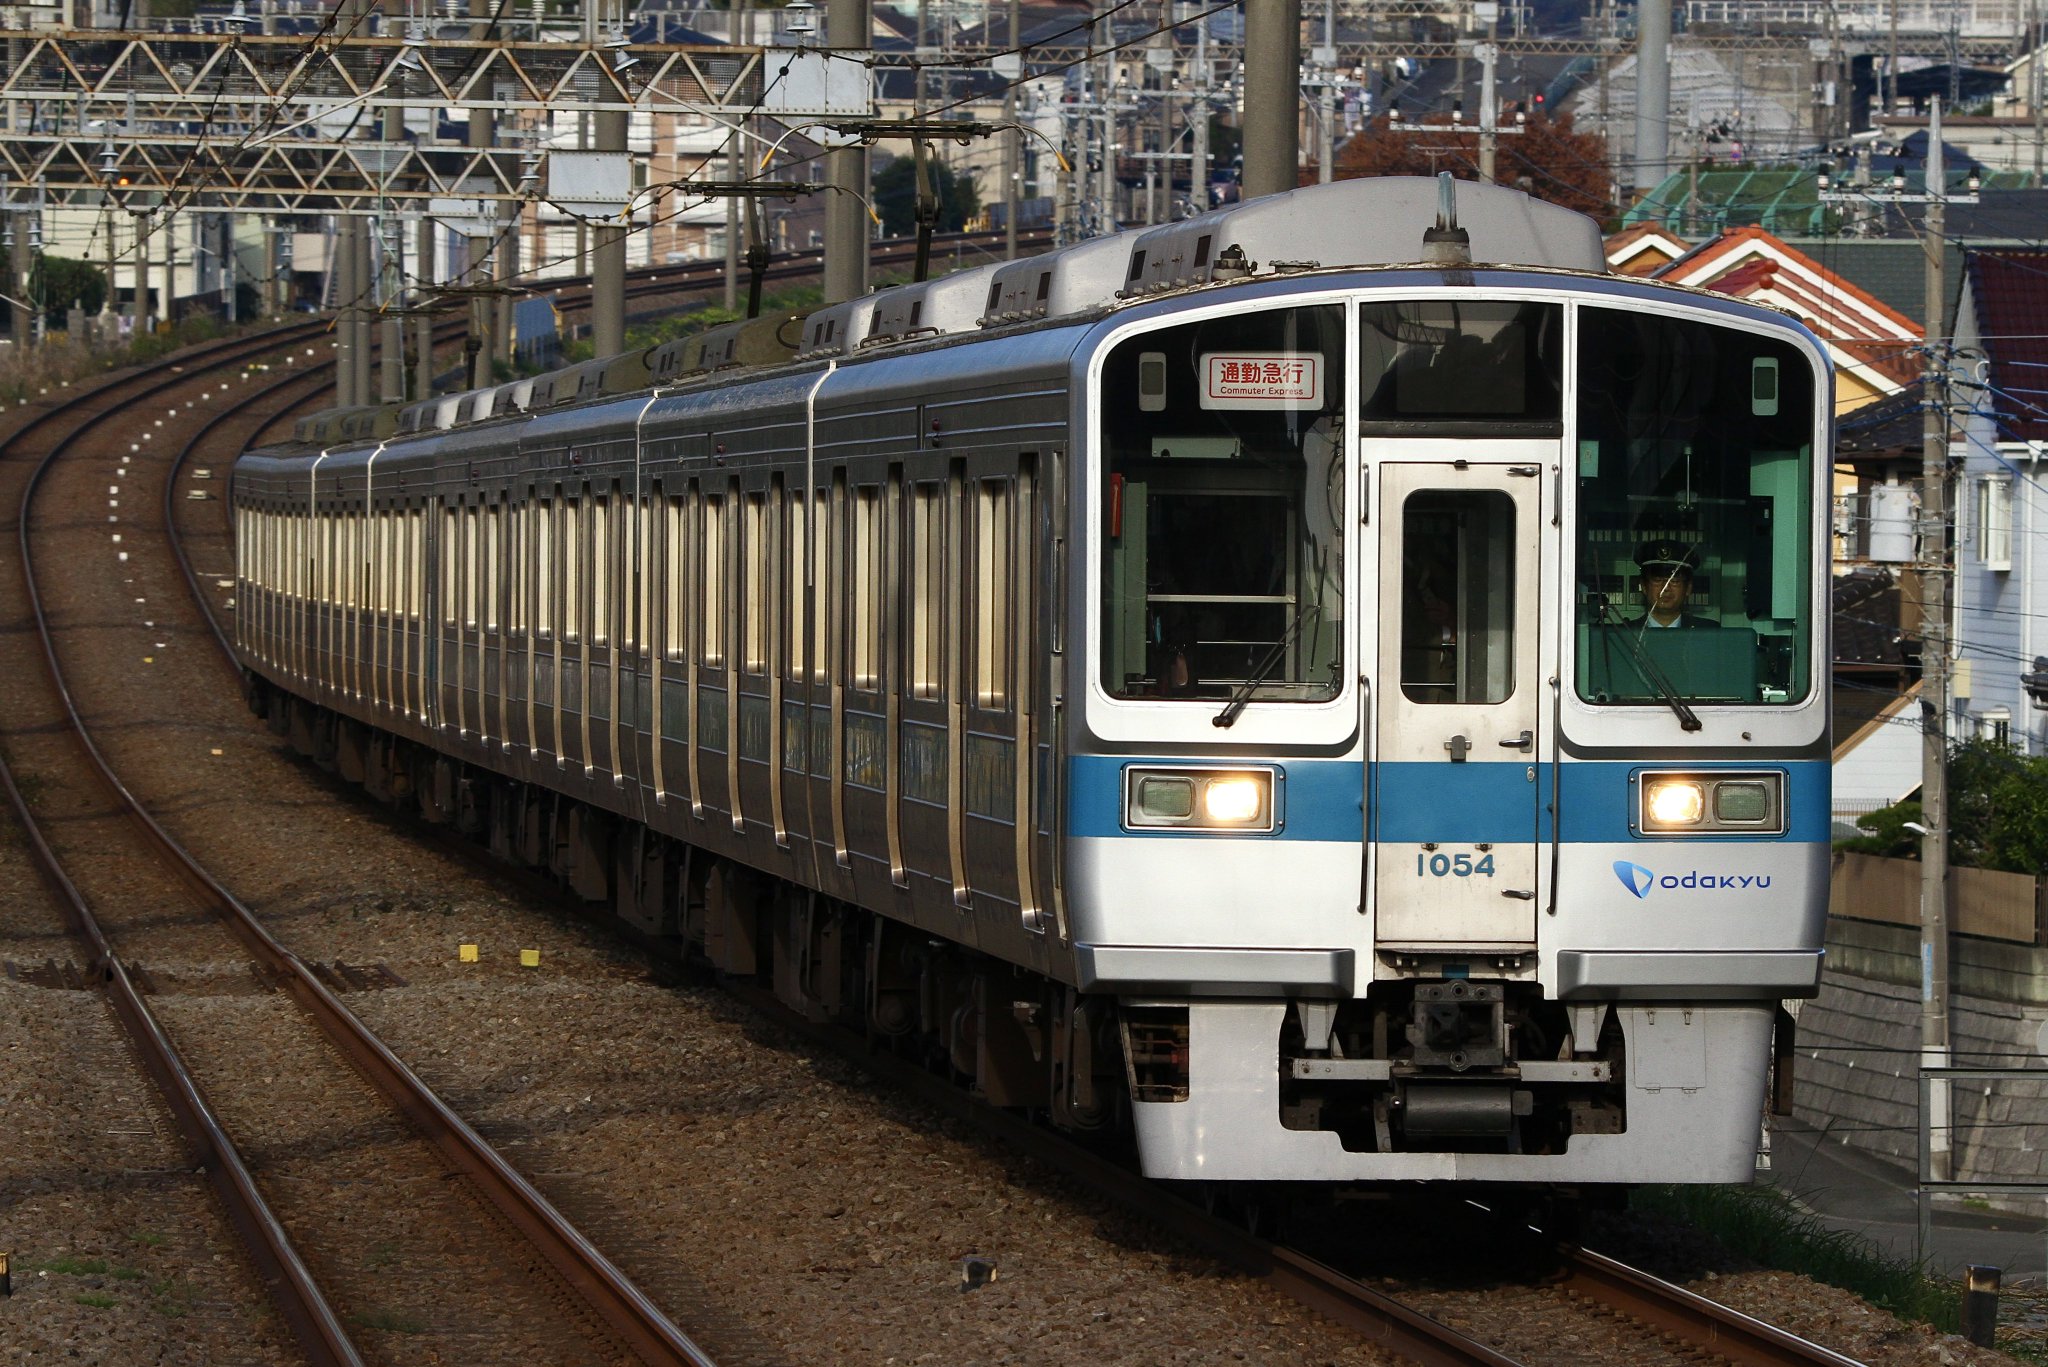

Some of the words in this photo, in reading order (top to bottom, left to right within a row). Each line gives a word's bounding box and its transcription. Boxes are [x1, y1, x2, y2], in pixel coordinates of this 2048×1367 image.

[1220, 362, 1304, 384] 通勤急行
[1220, 386, 1265, 395] Commuter
[1268, 387, 1304, 396] Express
[1417, 853, 1495, 877] 1054
[1660, 870, 1771, 889] odakyu
